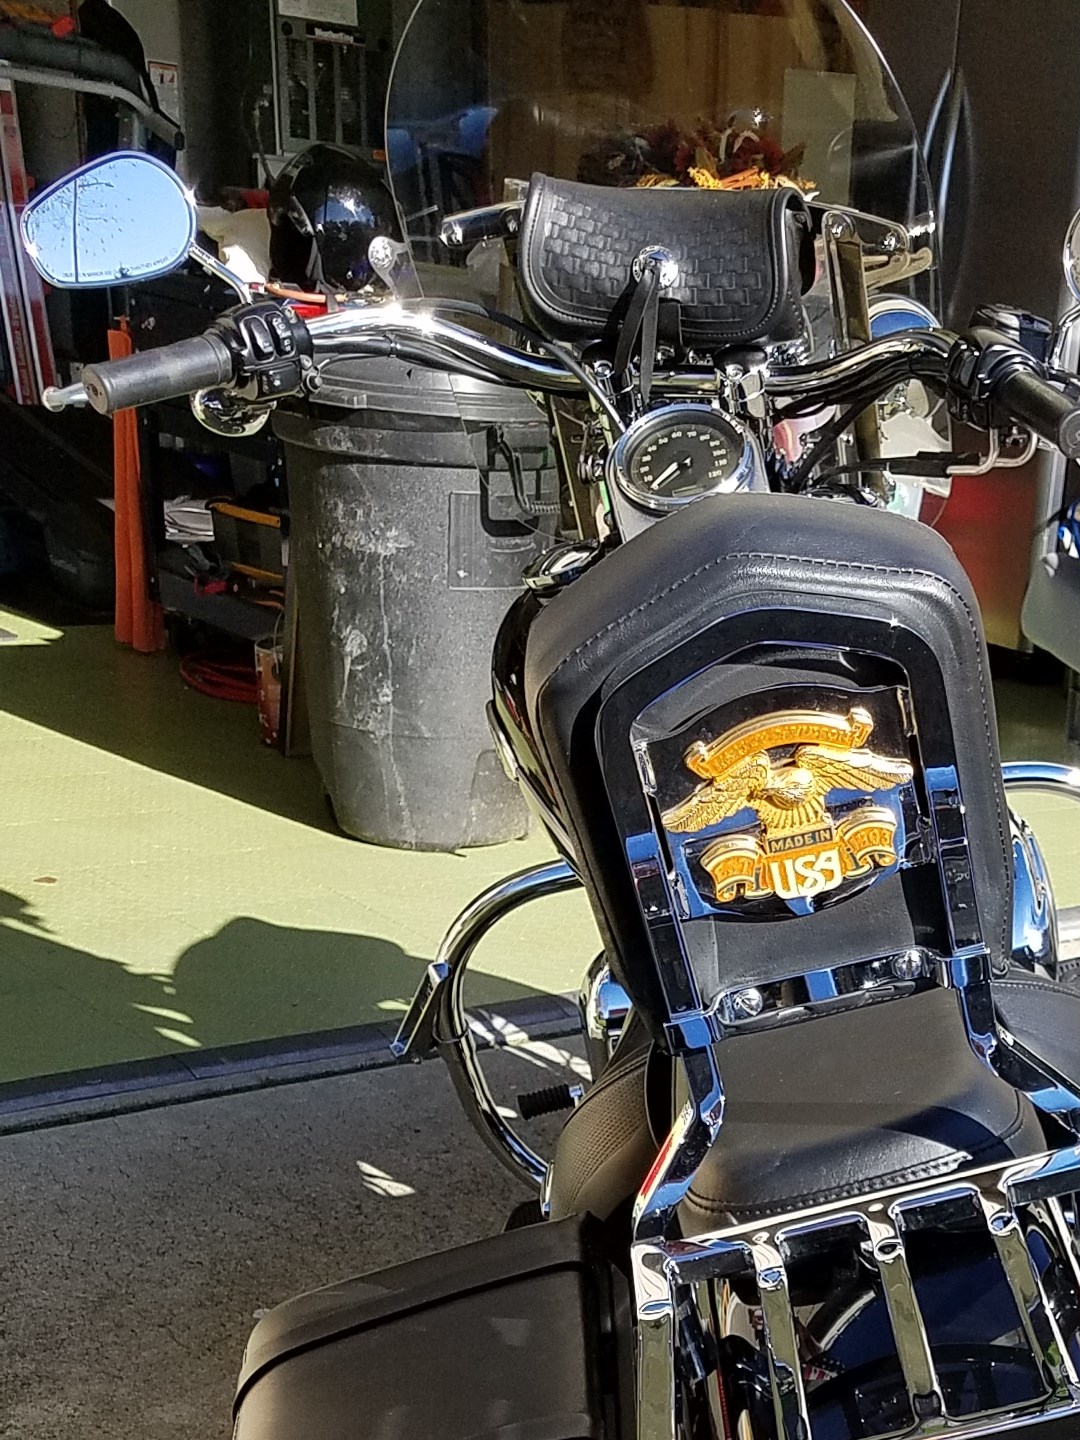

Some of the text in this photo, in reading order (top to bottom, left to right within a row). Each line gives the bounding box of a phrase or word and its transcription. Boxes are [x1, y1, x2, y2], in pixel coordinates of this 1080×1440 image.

[770, 829, 832, 852] MADE IN
[769, 849, 843, 900] USA
